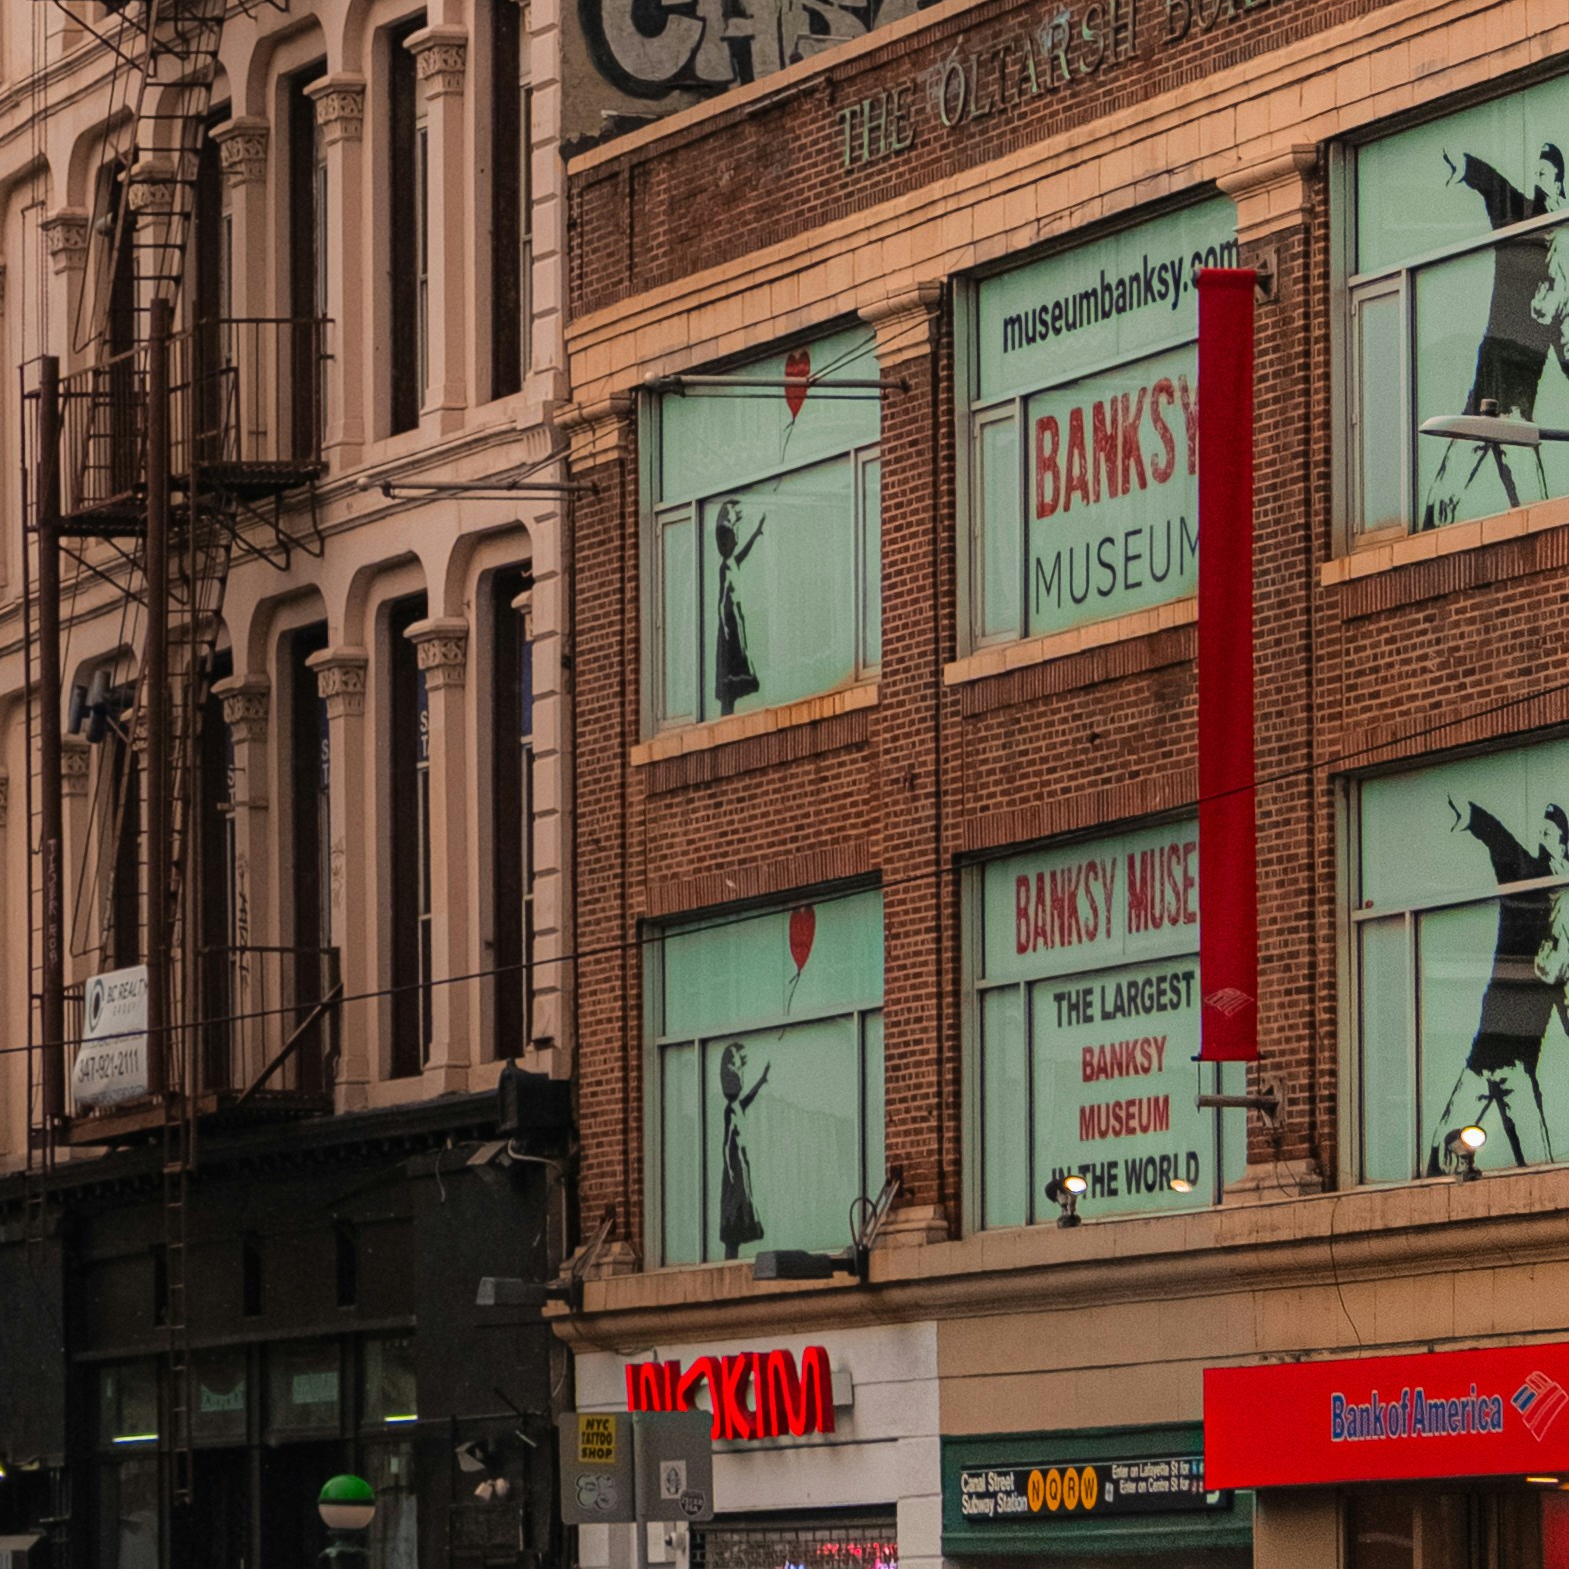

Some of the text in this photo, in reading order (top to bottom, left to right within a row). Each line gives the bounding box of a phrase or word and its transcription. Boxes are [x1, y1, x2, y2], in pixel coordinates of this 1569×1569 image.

[837, 81, 917, 167] THE
[1015, 856, 1118, 956] BANKSY
[1053, 969, 1196, 1029] THE LARGEST
[1081, 1035, 1168, 1083] BANKSY
[1079, 1094, 1171, 1142] MUSEUM
[1078, 1159, 1119, 1200] THE
[1124, 1150, 1200, 1196] WORLD
[585, 1417, 610, 1432] NYC
[1331, 1382, 1503, 1441] Bank of America
[581, 1431, 613, 1446] TATTOO
[581, 1446, 613, 1460] SHOP
[960, 1471, 1015, 1493] Canal Street
[961, 1492, 1028, 1517] Subway Station
